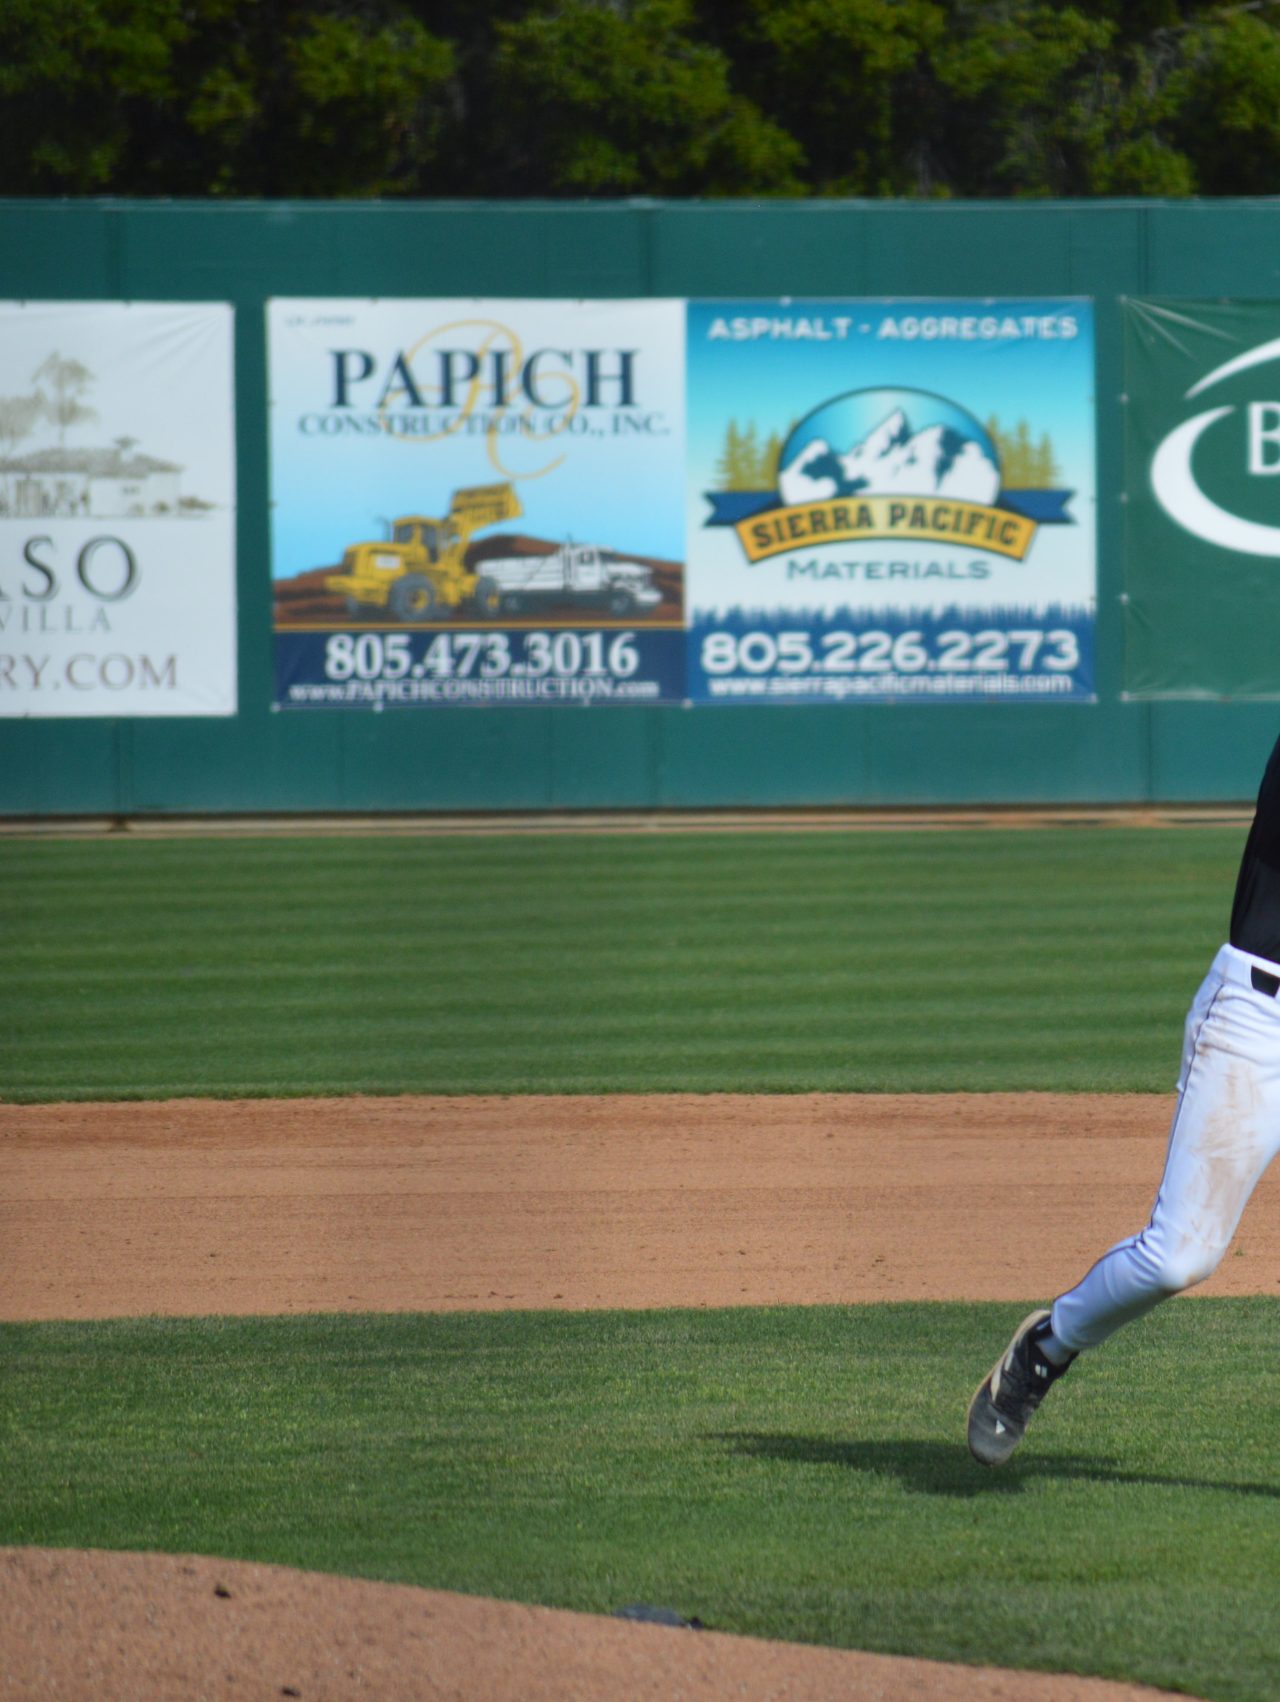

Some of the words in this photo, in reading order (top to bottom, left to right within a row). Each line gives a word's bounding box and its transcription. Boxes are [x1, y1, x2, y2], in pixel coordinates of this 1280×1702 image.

[707, 316, 852, 341] ASPHALT
[876, 315, 1079, 341] AGGREGATES
[327, 346, 640, 409] PAPICH
[297, 411, 538, 438] CONSTRUCTION
[610, 411, 671, 437] INC.
[751, 502, 874, 549] SIERRA
[888, 502, 1020, 546] PACIFIC
[0, 532, 141, 603] SO
[325, 632, 640, 680] 805.473.3016
[701, 629, 1080, 674] 805.226.2273
